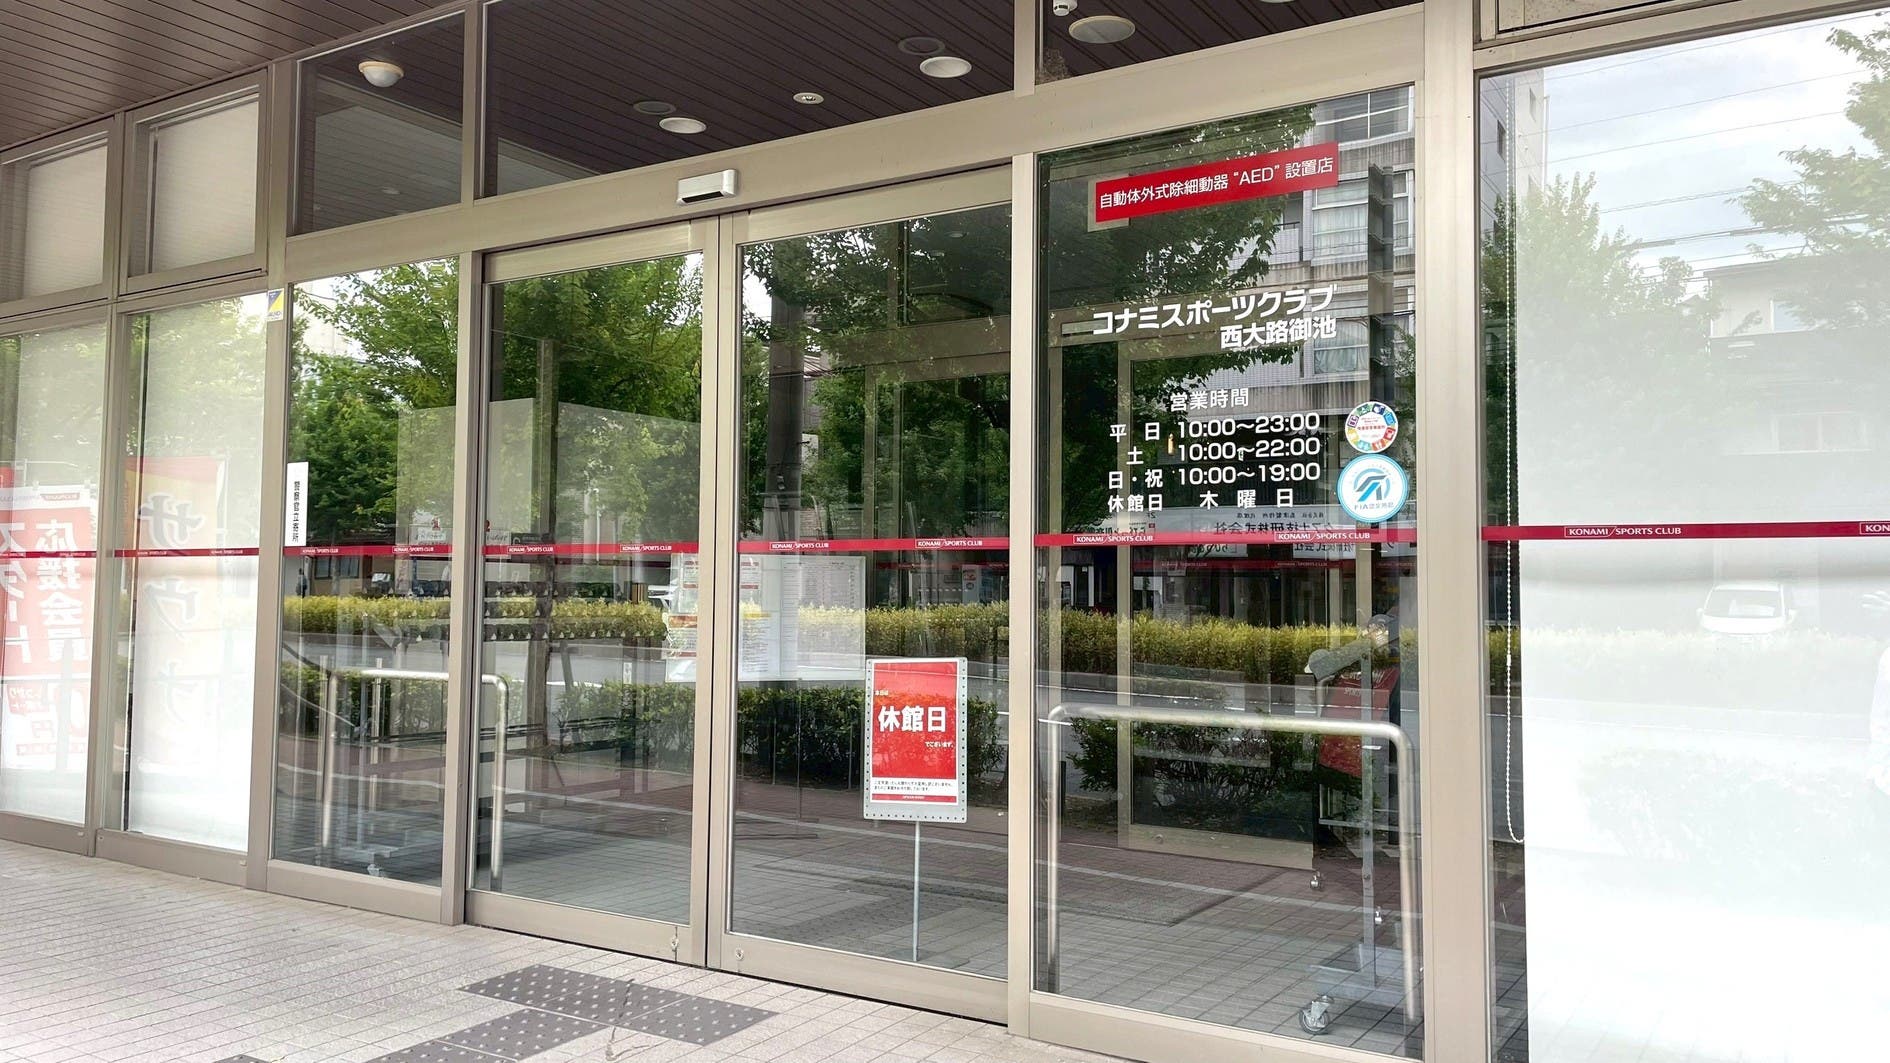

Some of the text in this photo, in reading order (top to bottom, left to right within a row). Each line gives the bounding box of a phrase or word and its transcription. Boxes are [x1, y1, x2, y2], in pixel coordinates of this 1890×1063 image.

[1099, 173, 1229, 209] 自動体外式除細動器
[1285, 156, 1333, 179] 設置店
[1092, 284, 1338, 336] コナミスポーツクラブ
[1219, 316, 1337, 349] 西大路御池
[1170, 388, 1249, 412] 営業時間
[1127, 448, 1144, 466] 土
[1107, 493, 1163, 513] 休館日
[1316, 532, 1347, 540] SPORTS
[1569, 527, 1682, 536] KONAMI SPORTS CLUB
[877, 705, 946, 733] 休館日
